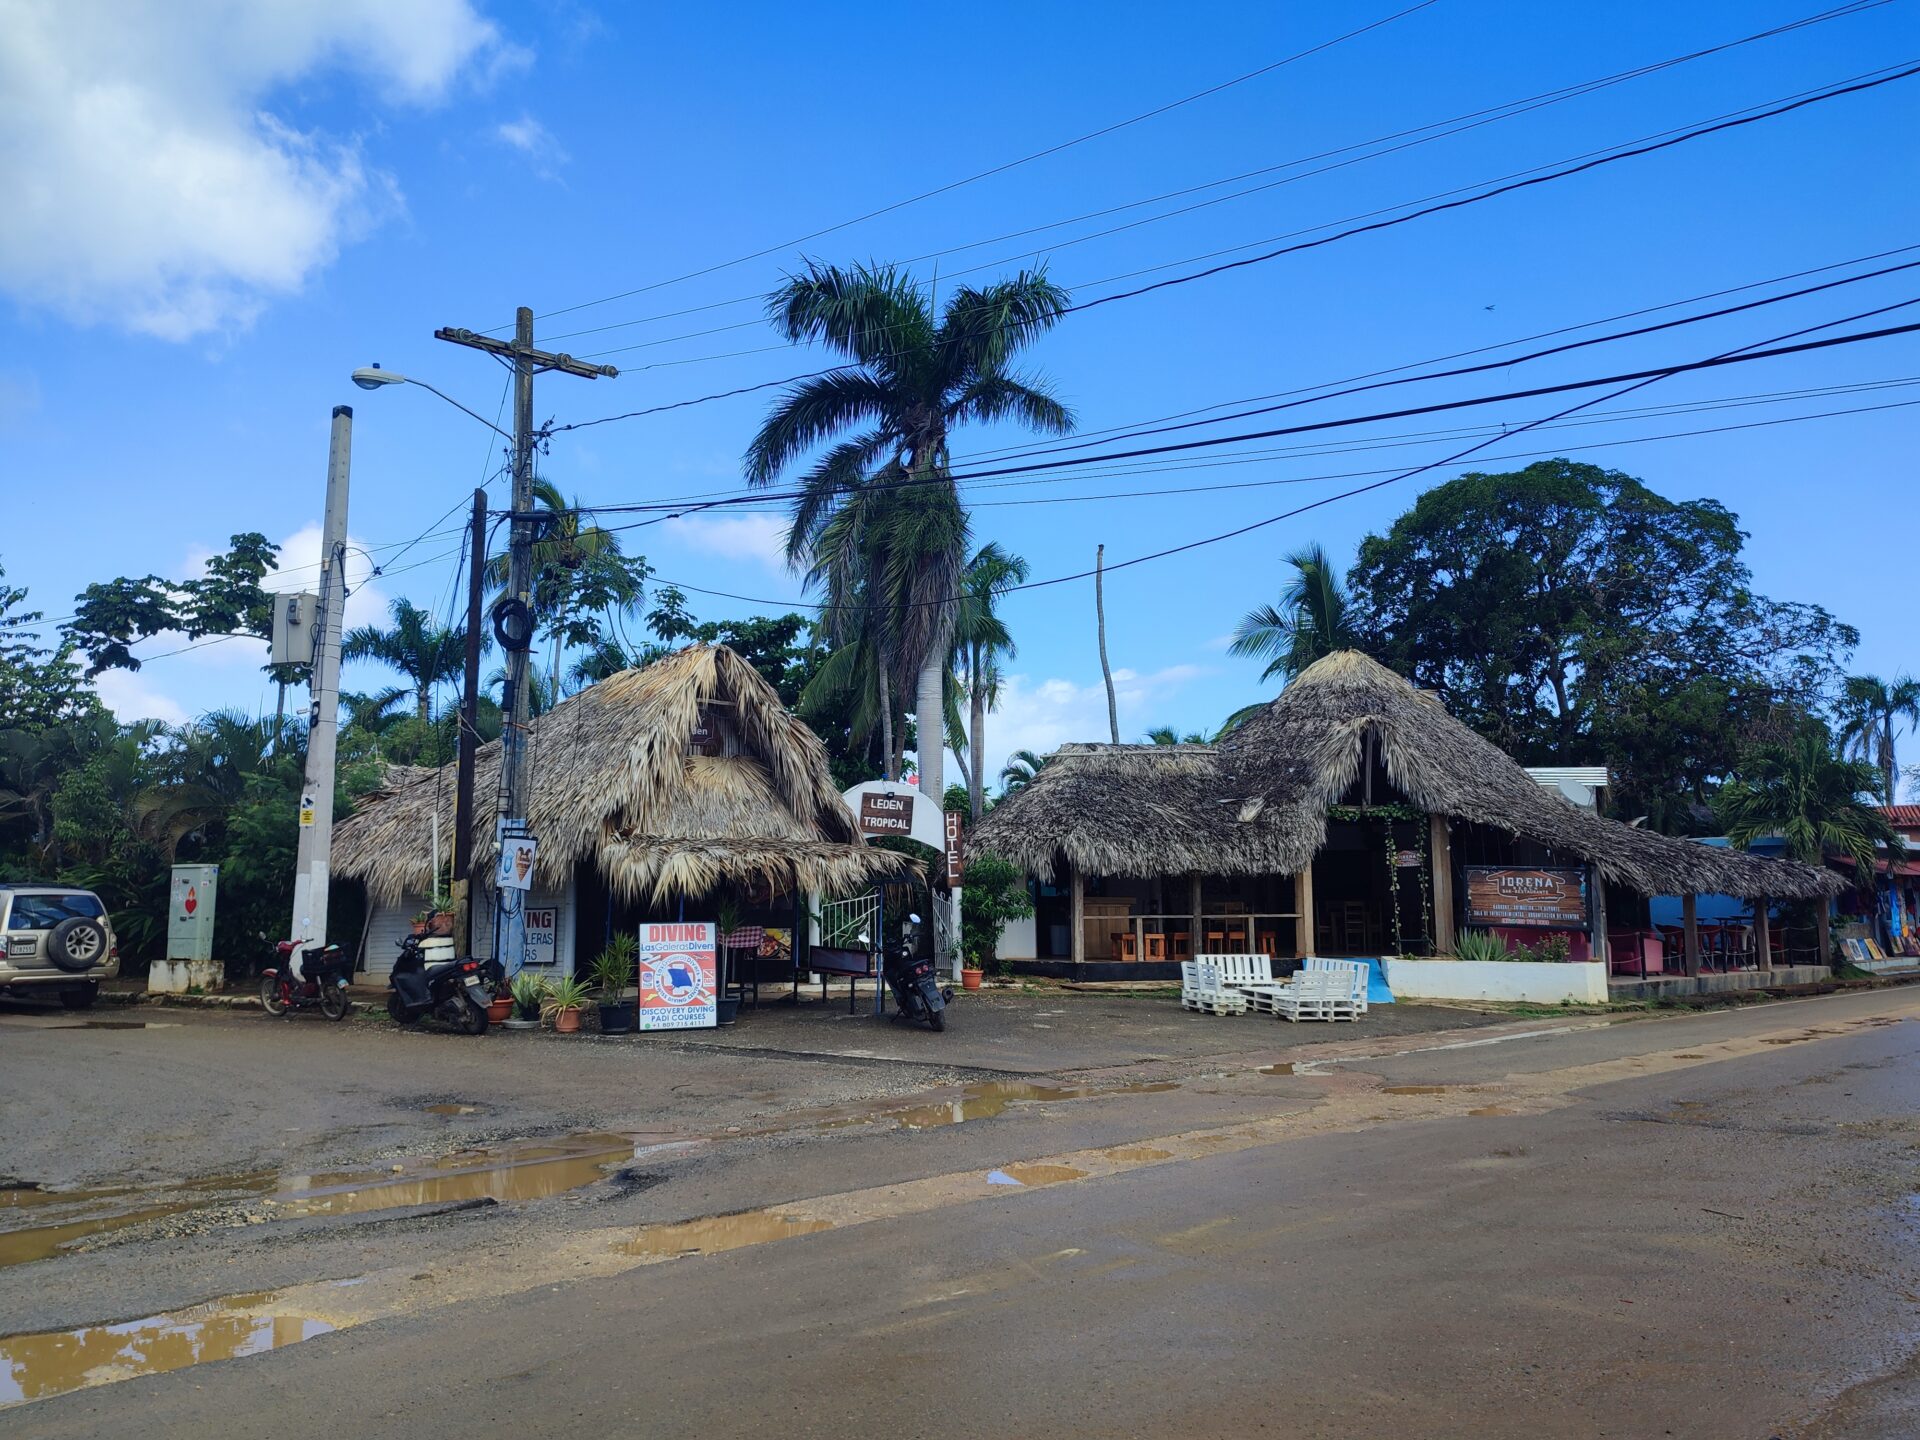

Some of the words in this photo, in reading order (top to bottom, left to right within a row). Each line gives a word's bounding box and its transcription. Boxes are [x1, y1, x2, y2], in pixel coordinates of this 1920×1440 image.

[870, 798, 904, 811] LEDEN
[863, 816, 909, 830] TROPICAL
[946, 812, 960, 878] HOTEL
[649, 924, 706, 942] DIVING
[641, 942, 714, 952] LasGalerasDivers
[641, 1007, 685, 1015] DISCOVERY
[671, 1013, 706, 1021] COURSES
